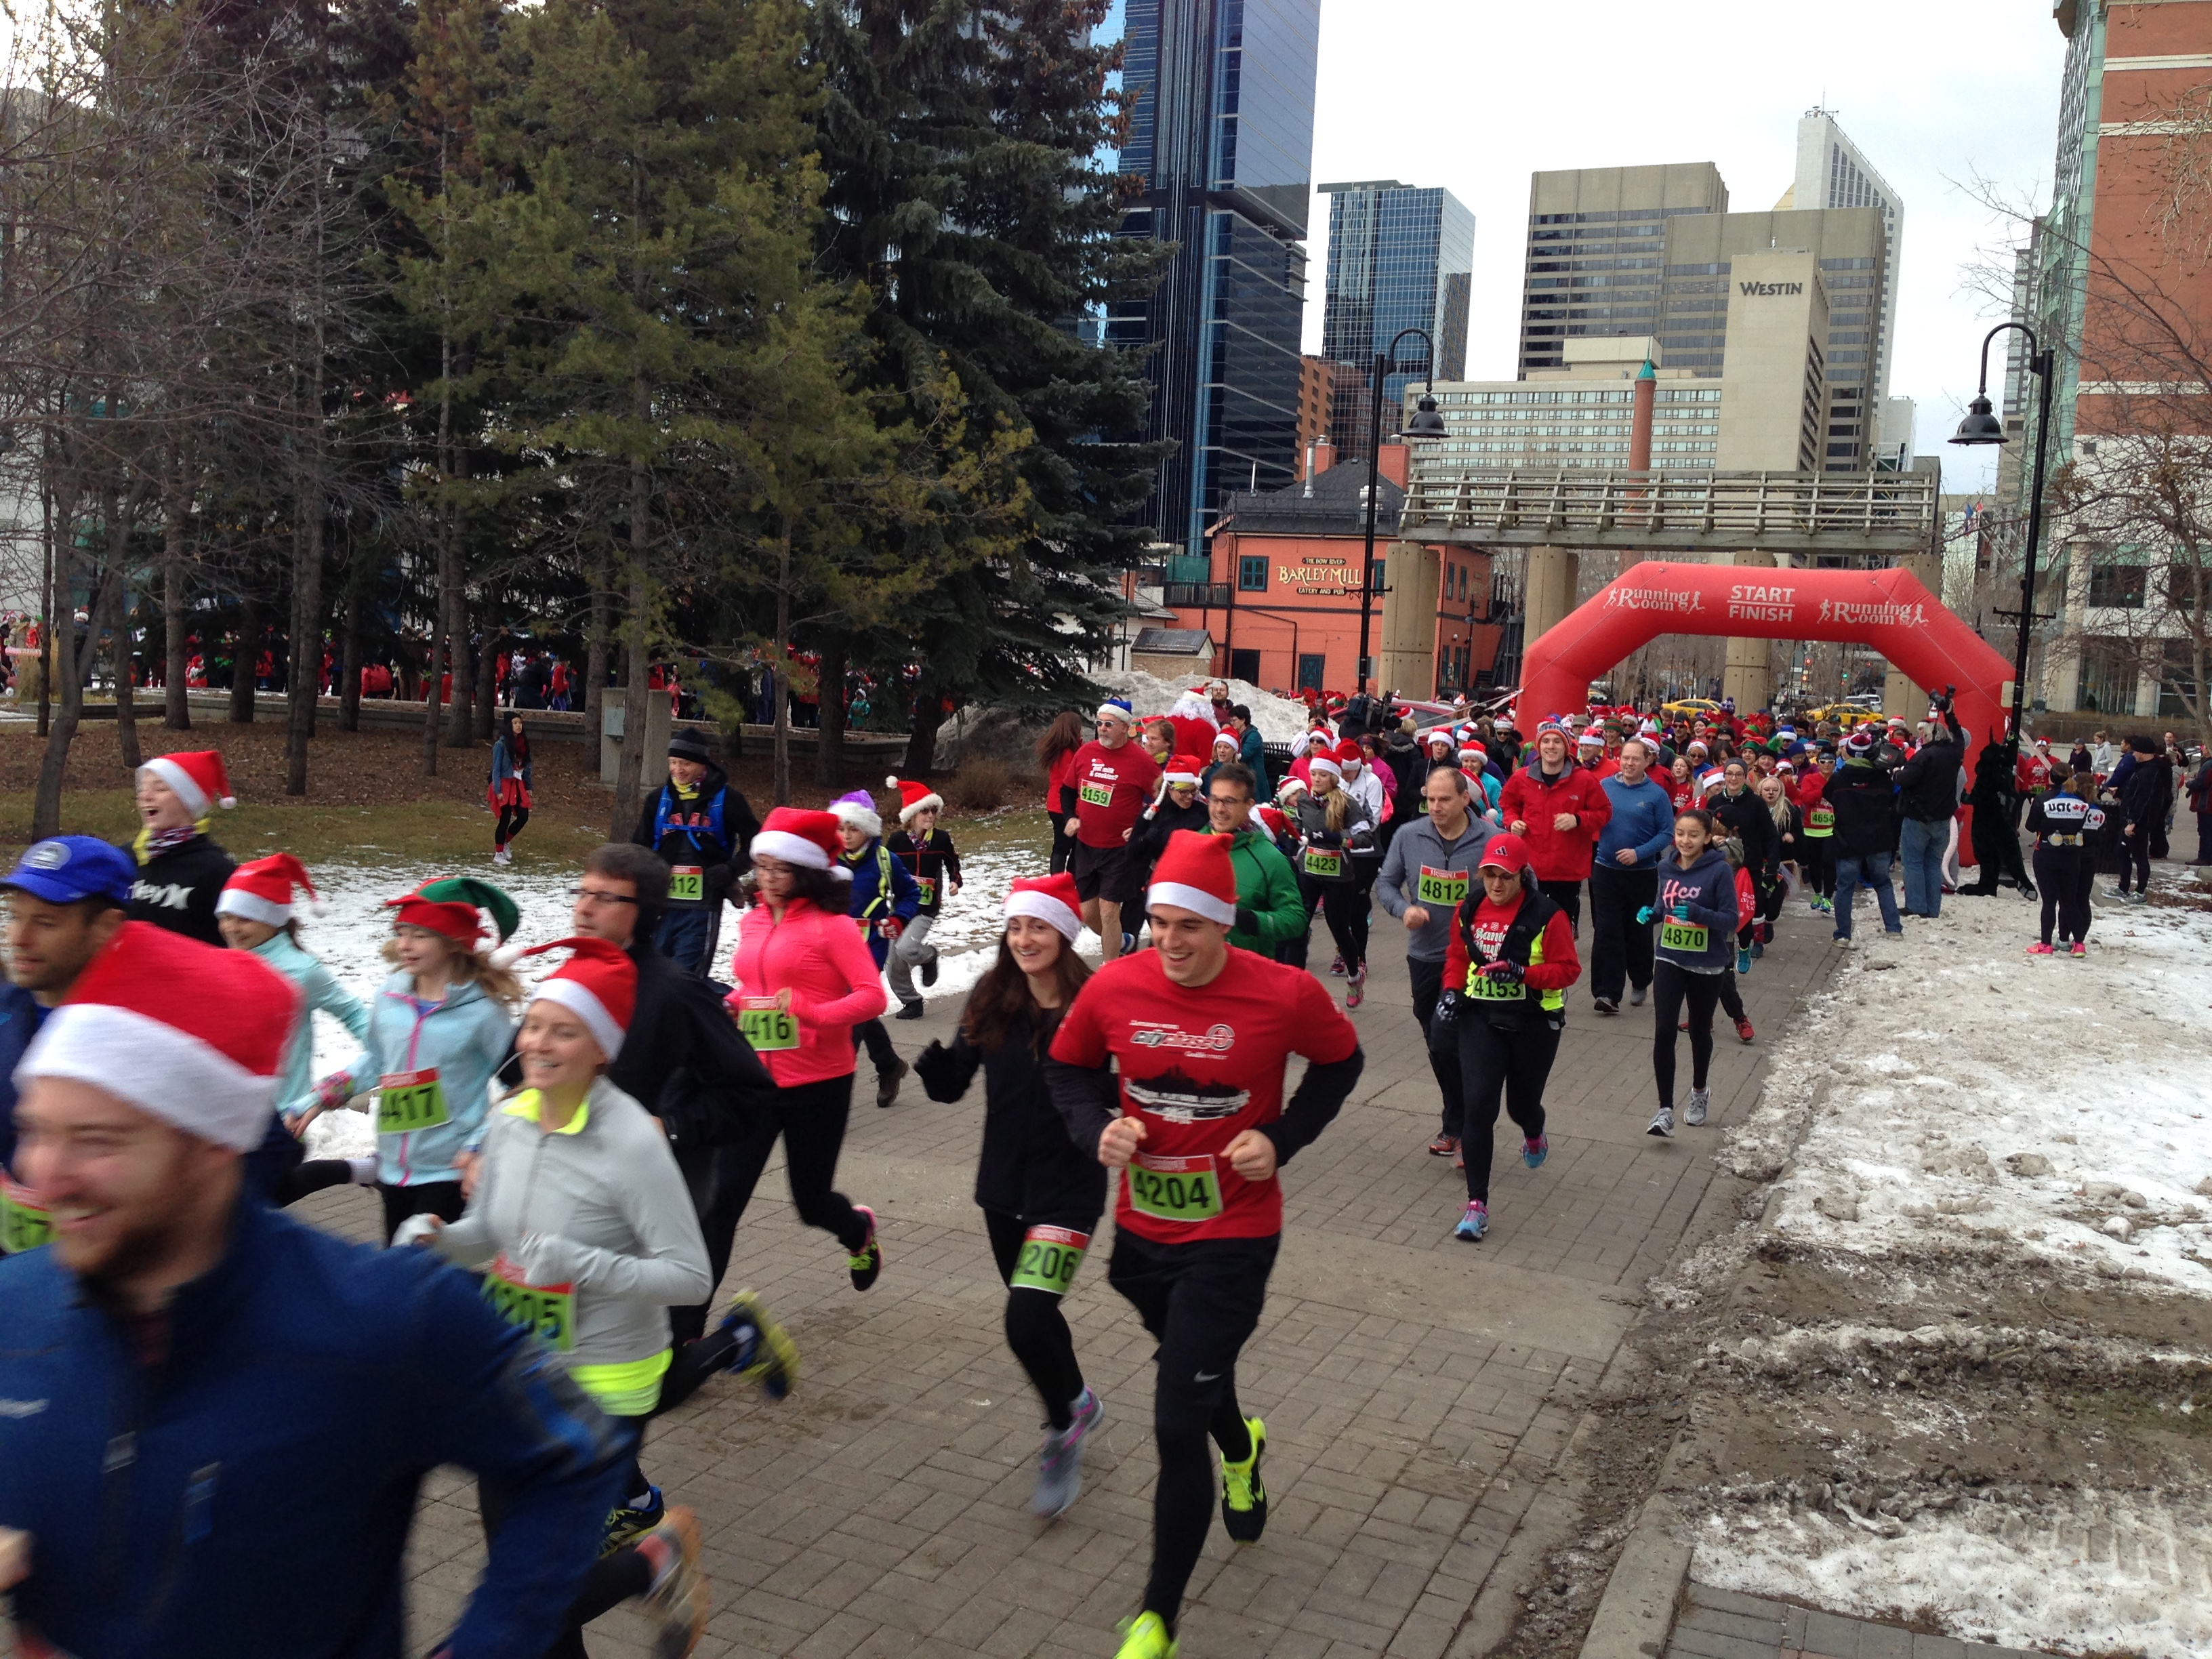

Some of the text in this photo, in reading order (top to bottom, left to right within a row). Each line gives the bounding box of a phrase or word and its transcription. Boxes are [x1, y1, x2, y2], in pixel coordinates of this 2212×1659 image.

[1276, 566, 1362, 586] BARLEY MILL
[1618, 588, 1689, 609] Running
[1731, 584, 1796, 602] START
[1729, 605, 1793, 622] FINISH
[1832, 601, 1912, 623] Running
[1082, 787, 1108, 804] 4159
[1812, 814, 1834, 823] 4654
[1307, 855, 1336, 872] 4423
[1422, 879, 1465, 900] 4812
[1664, 927, 1704, 947] 4870
[1474, 977, 1521, 998] 4153
[1134, 1171, 1210, 1209] 4204
